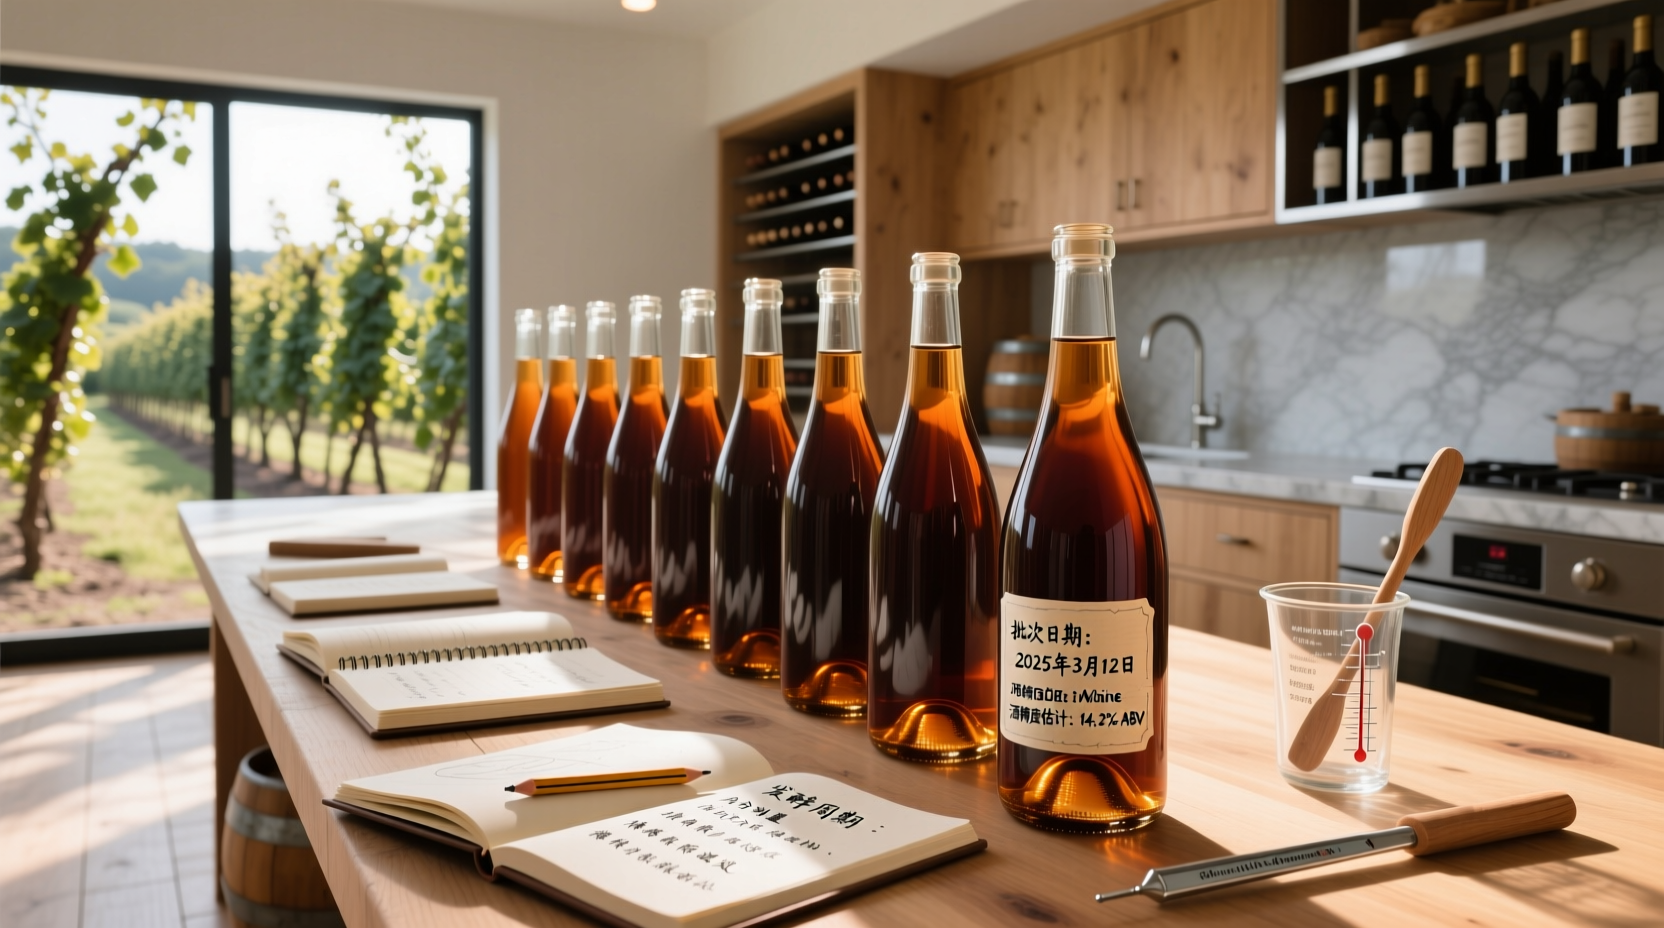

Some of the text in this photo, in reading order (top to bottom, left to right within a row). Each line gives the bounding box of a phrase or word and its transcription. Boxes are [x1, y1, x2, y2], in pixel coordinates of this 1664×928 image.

[1010, 619, 1091, 648] 批次日期：
[1014, 652, 1134, 677] 2025年3月12日
[1080, 711, 1119, 727] 14.2%
[1120, 710, 1145, 727] ABV
